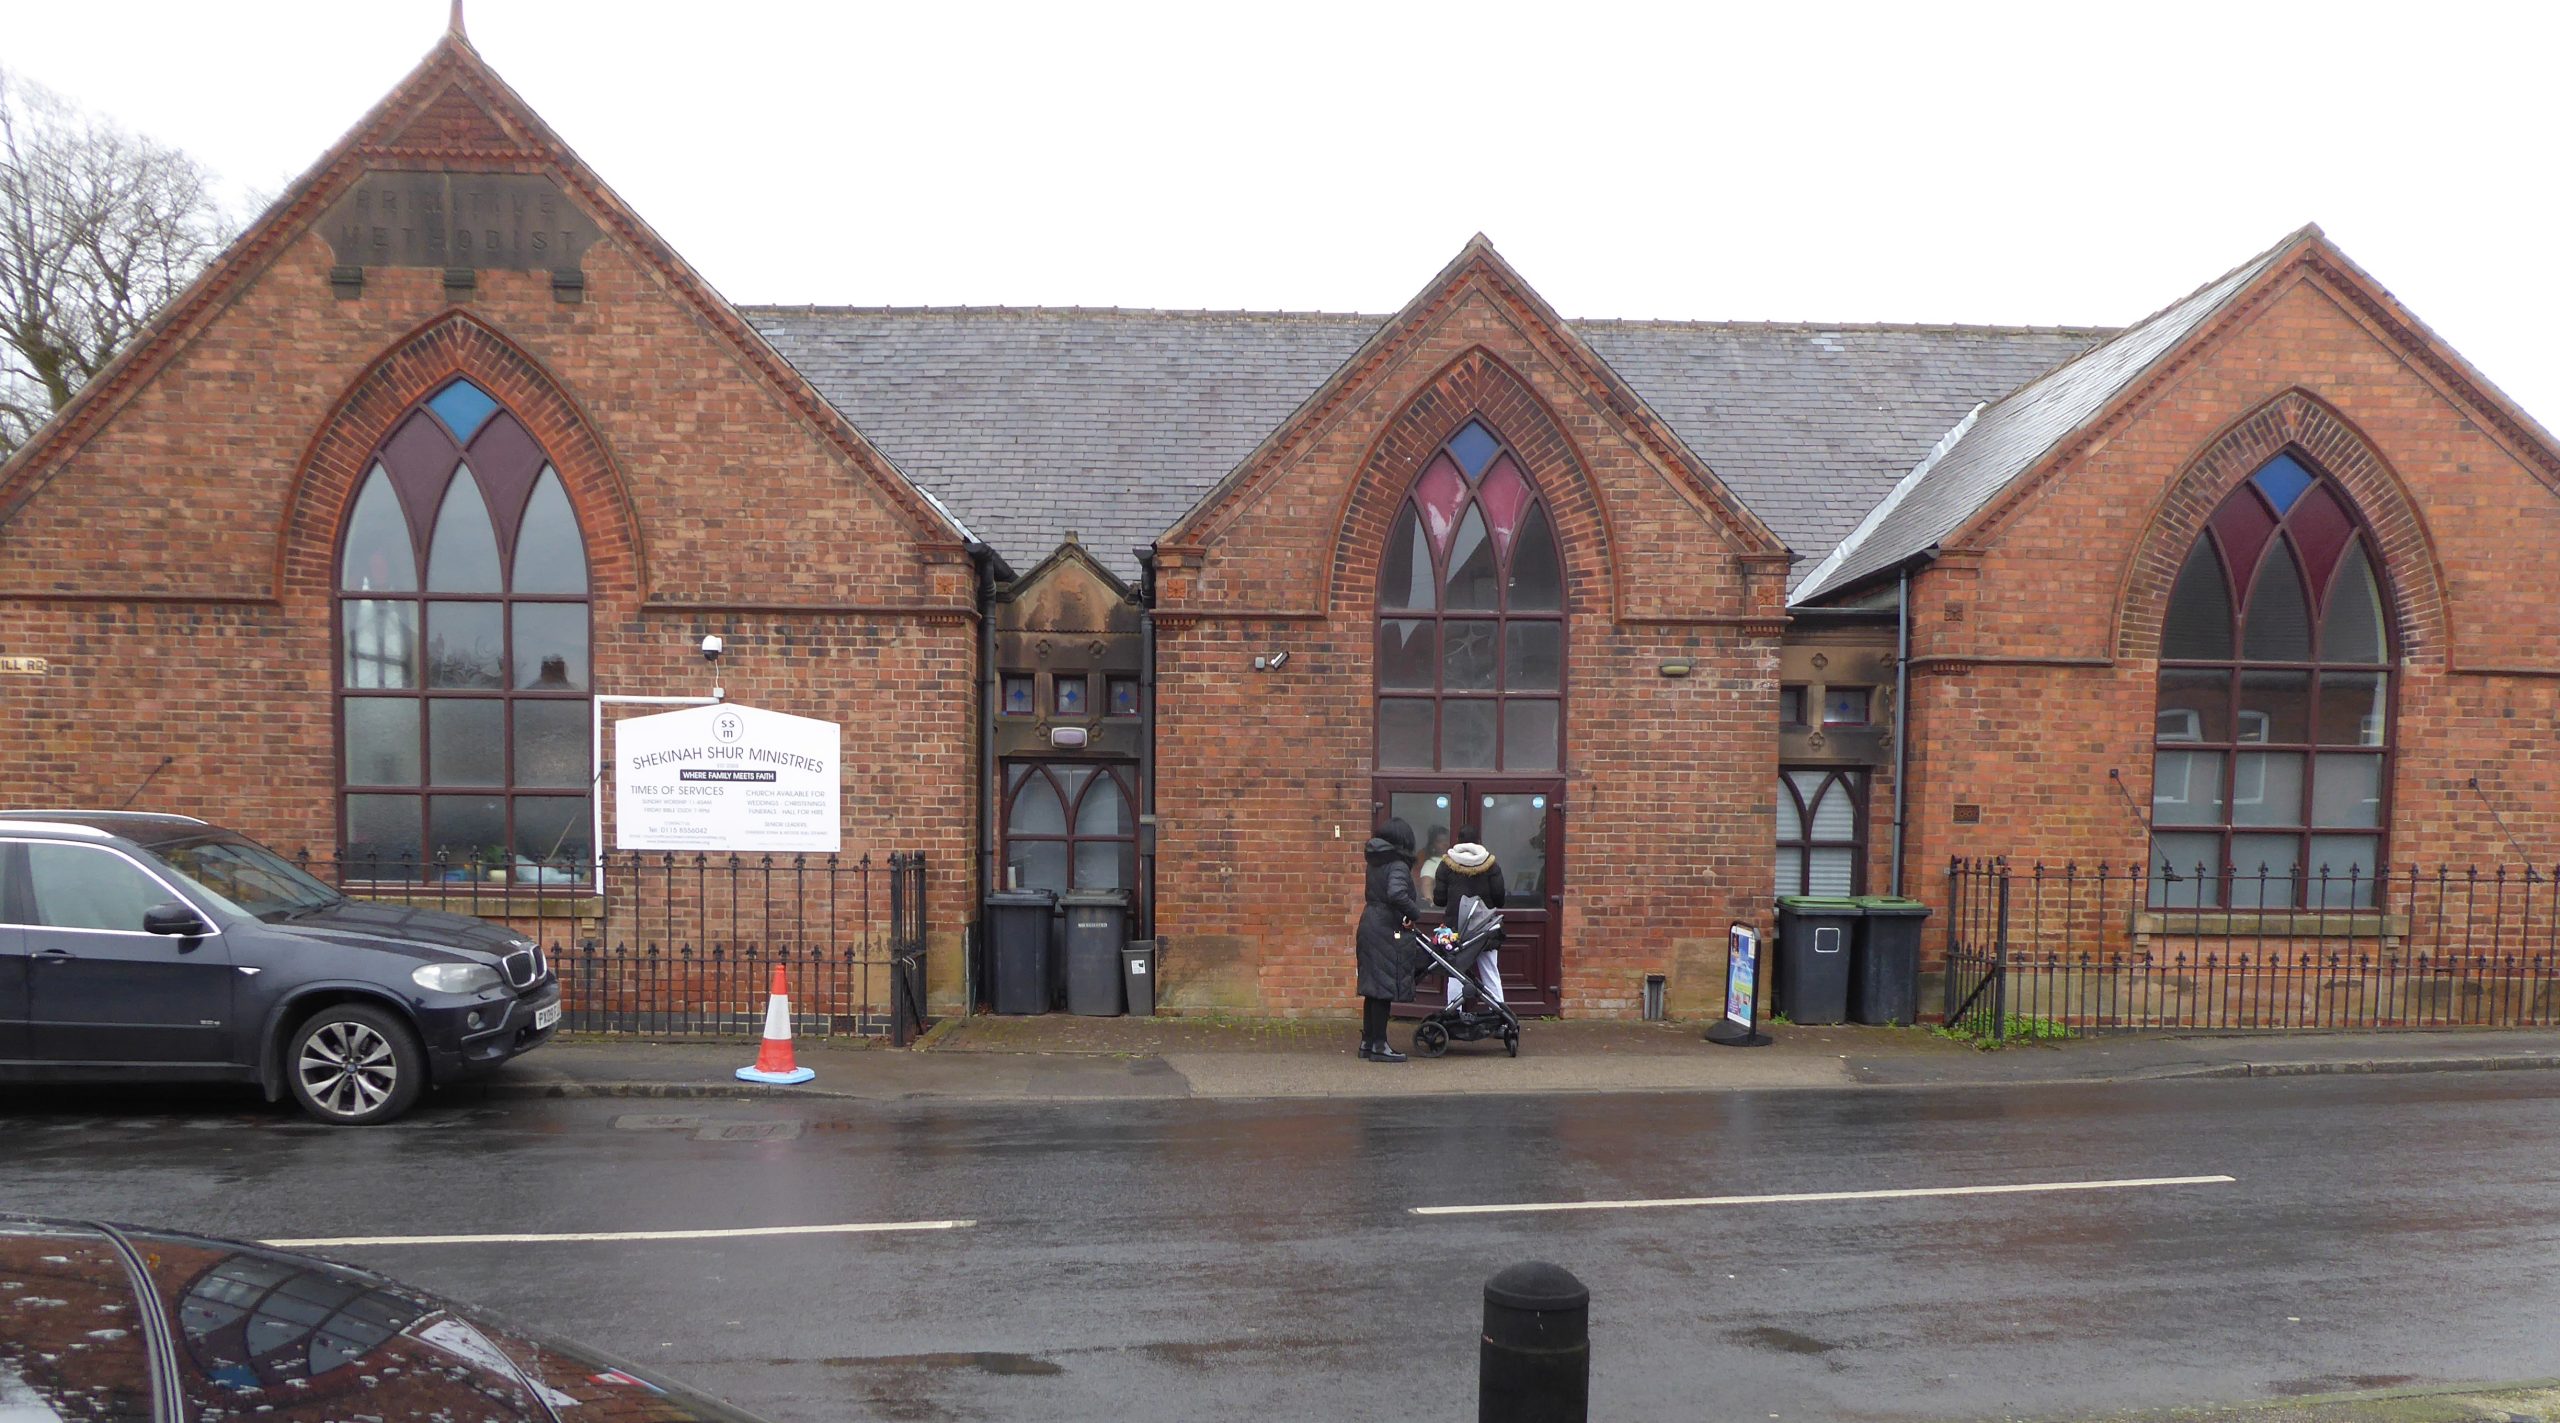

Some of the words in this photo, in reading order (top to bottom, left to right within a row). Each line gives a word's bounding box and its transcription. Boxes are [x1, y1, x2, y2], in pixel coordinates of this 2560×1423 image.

[356, 189, 556, 217] PRIMITIVE
[342, 224, 577, 252] METHODIST
[632, 747, 703, 770] SHEKINAH
[707, 746, 744, 760] SHUR
[749, 747, 824, 774] MINISTRIES
[682, 771, 707, 780] WHERE
[708, 771, 732, 780] FAMILY
[733, 772, 755, 781] MEETS
[755, 772, 775, 781] FAITH
[631, 785, 658, 795] TIMES
[661, 785, 675, 796] OF
[678, 786, 724, 797] SERVICES
[776, 790, 809, 798] AVAILABLE
[784, 800, 826, 808] CHRISTENINGS
